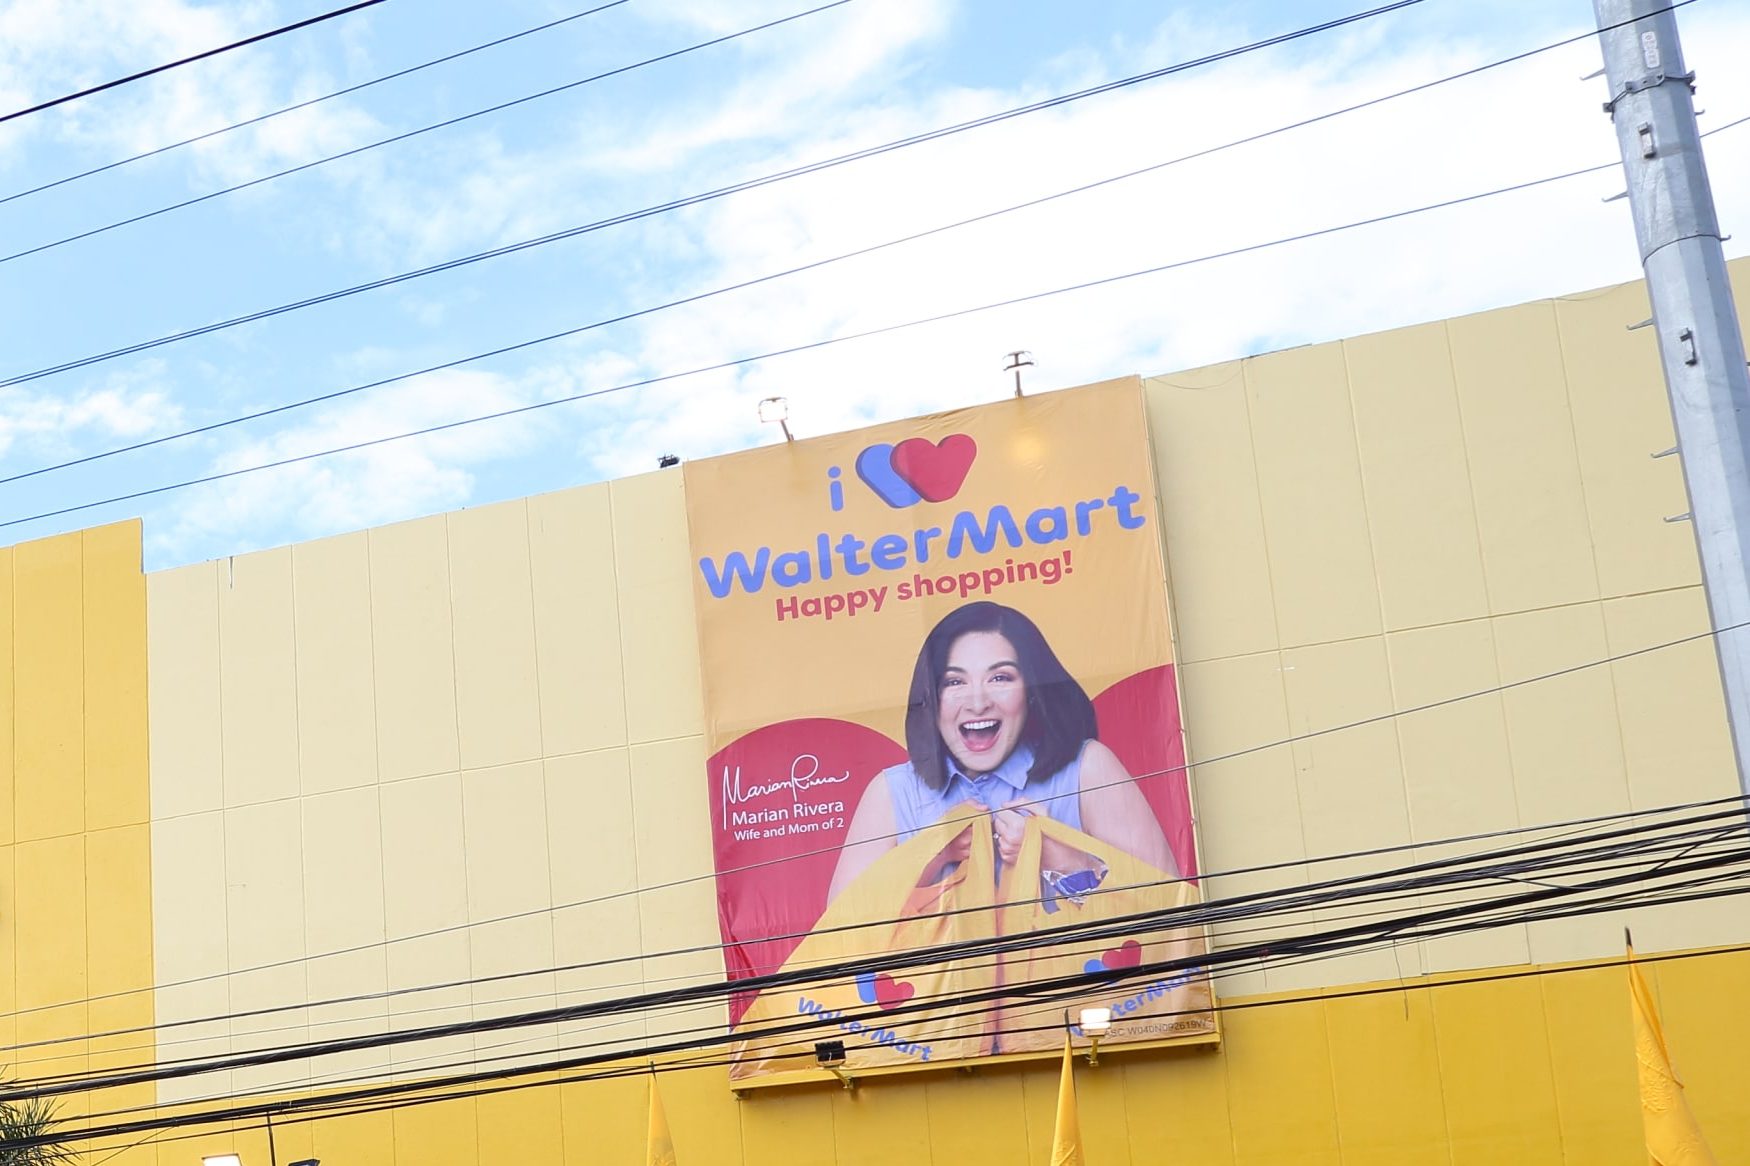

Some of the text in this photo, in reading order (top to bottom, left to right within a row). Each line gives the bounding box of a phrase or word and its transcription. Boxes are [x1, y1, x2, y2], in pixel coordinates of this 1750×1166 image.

[827, 466, 844, 512] i
[699, 486, 1146, 599] WalterMart
[775, 550, 1074, 621] Happy shopping!
[732, 801, 844, 826] Marian Rivera
[734, 818, 844, 841] Wife and Mom of 2
